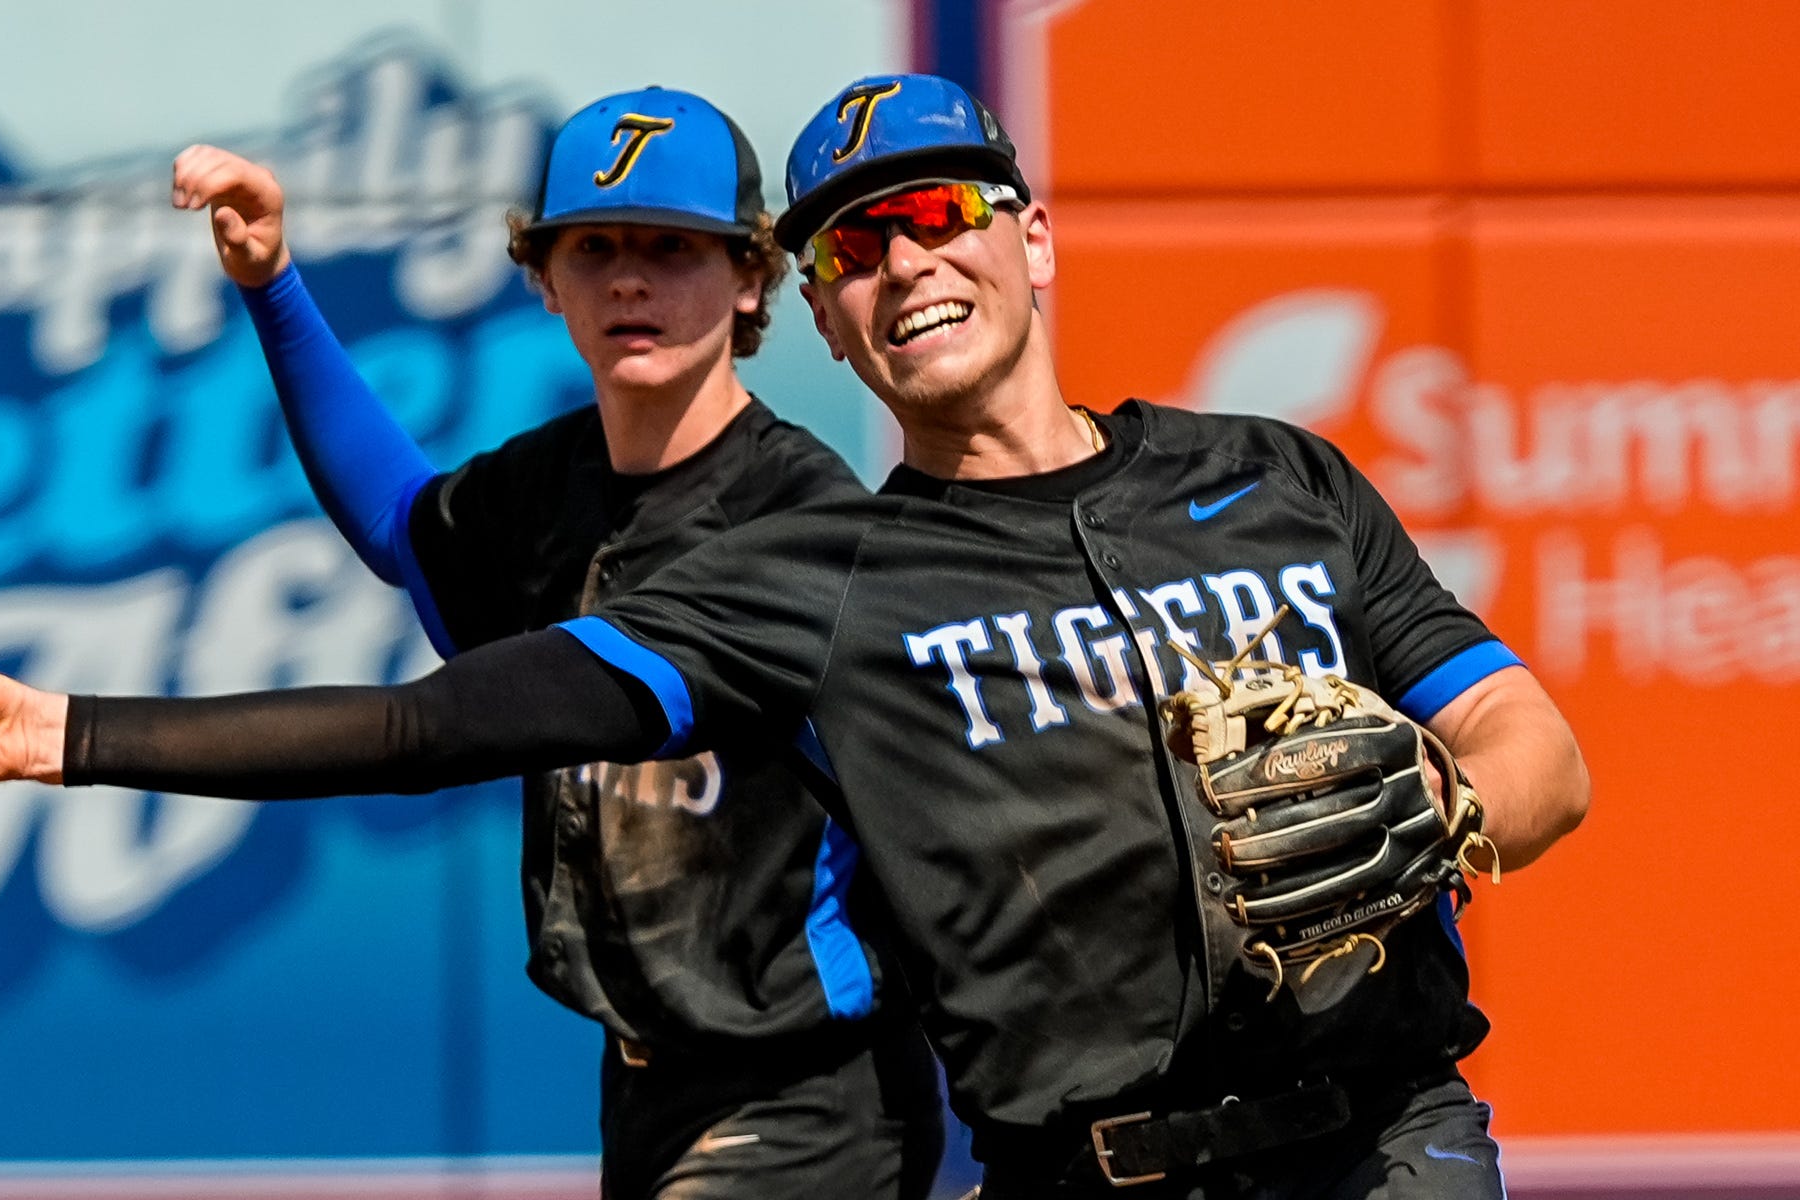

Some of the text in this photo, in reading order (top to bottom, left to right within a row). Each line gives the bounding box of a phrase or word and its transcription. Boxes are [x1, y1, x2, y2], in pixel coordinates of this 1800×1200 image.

[902, 561, 1350, 751] TIGERS
[1264, 738, 1349, 780] Rawlings
[1299, 925, 1323, 940] THE
[1322, 914, 1353, 931] GOLD
[1353, 899, 1387, 921] GLOVE
